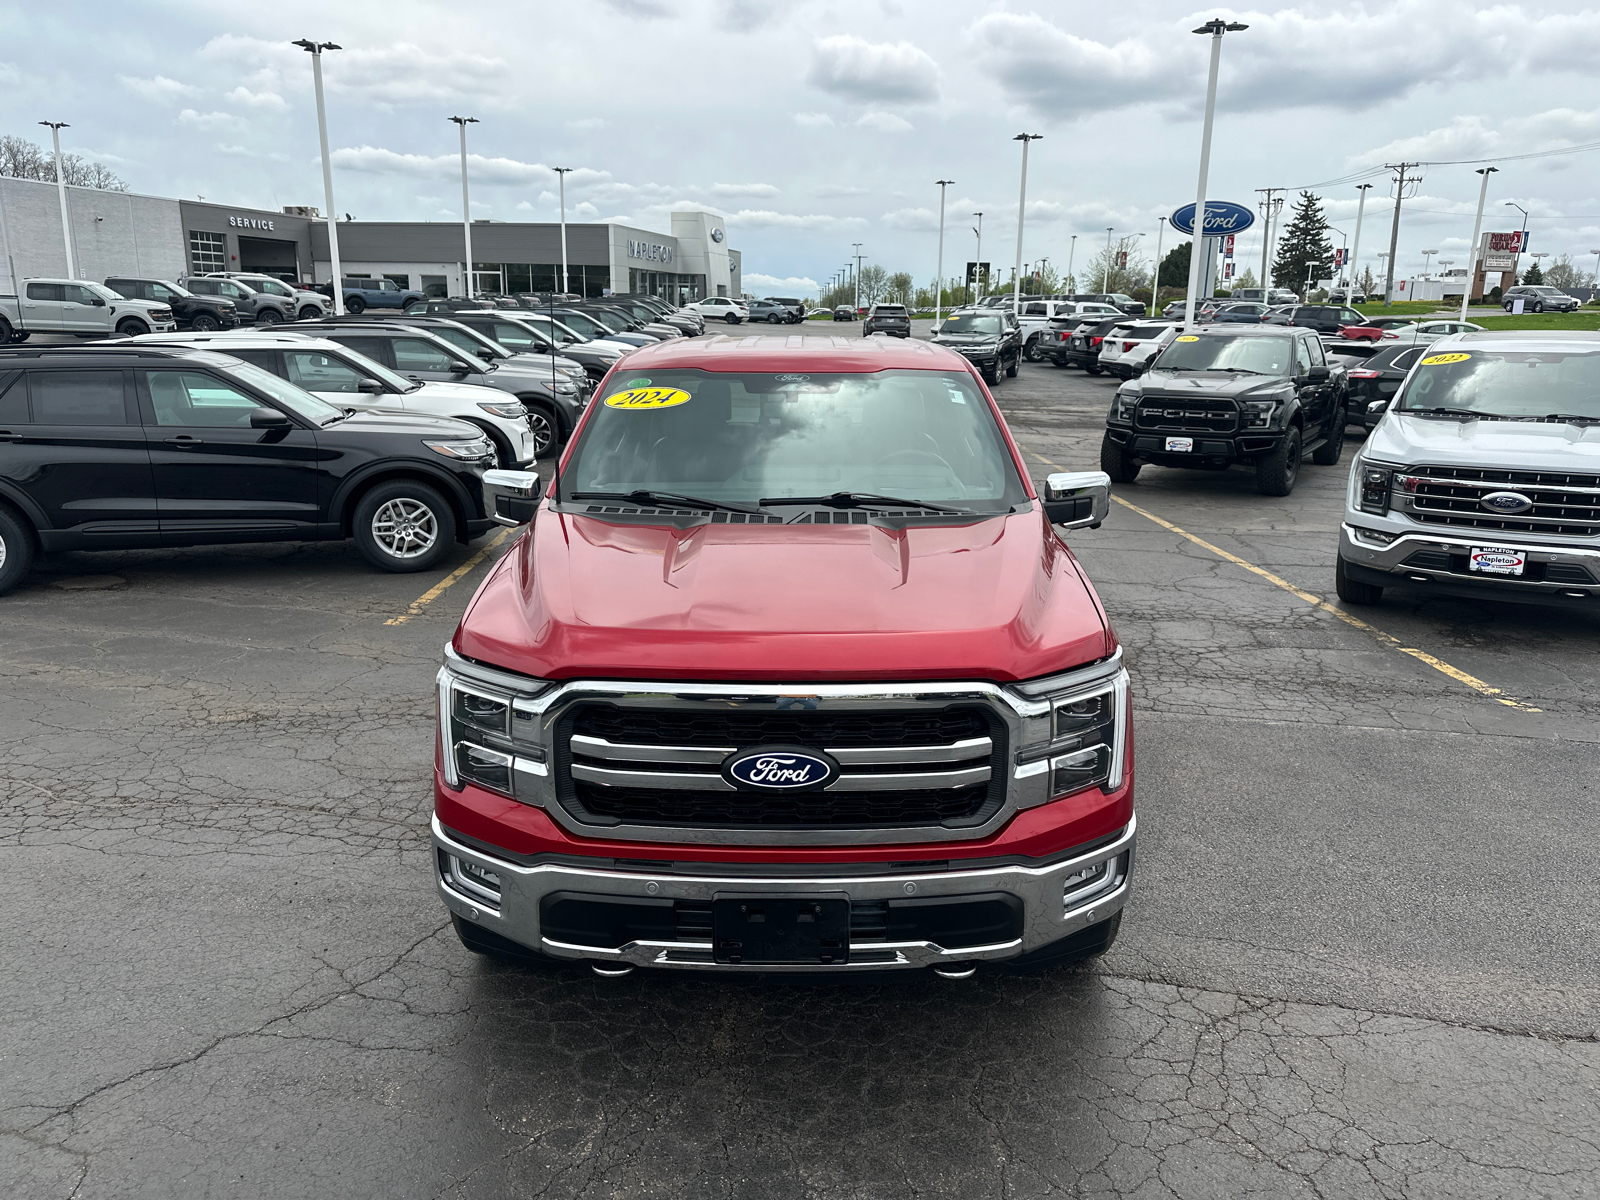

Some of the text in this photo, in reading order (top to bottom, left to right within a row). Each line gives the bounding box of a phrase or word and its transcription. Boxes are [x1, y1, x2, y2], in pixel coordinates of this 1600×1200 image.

[230, 216, 274, 231] SERVICE
[1189, 207, 1239, 228] Ford
[628, 239, 673, 263] NAPLETON
[1426, 354, 1463, 364] 2022
[615, 390, 678, 405] 2024
[1494, 497, 1519, 507] Ford
[1480, 555, 1515, 564] Napleton
[750, 757, 811, 782] Ford
